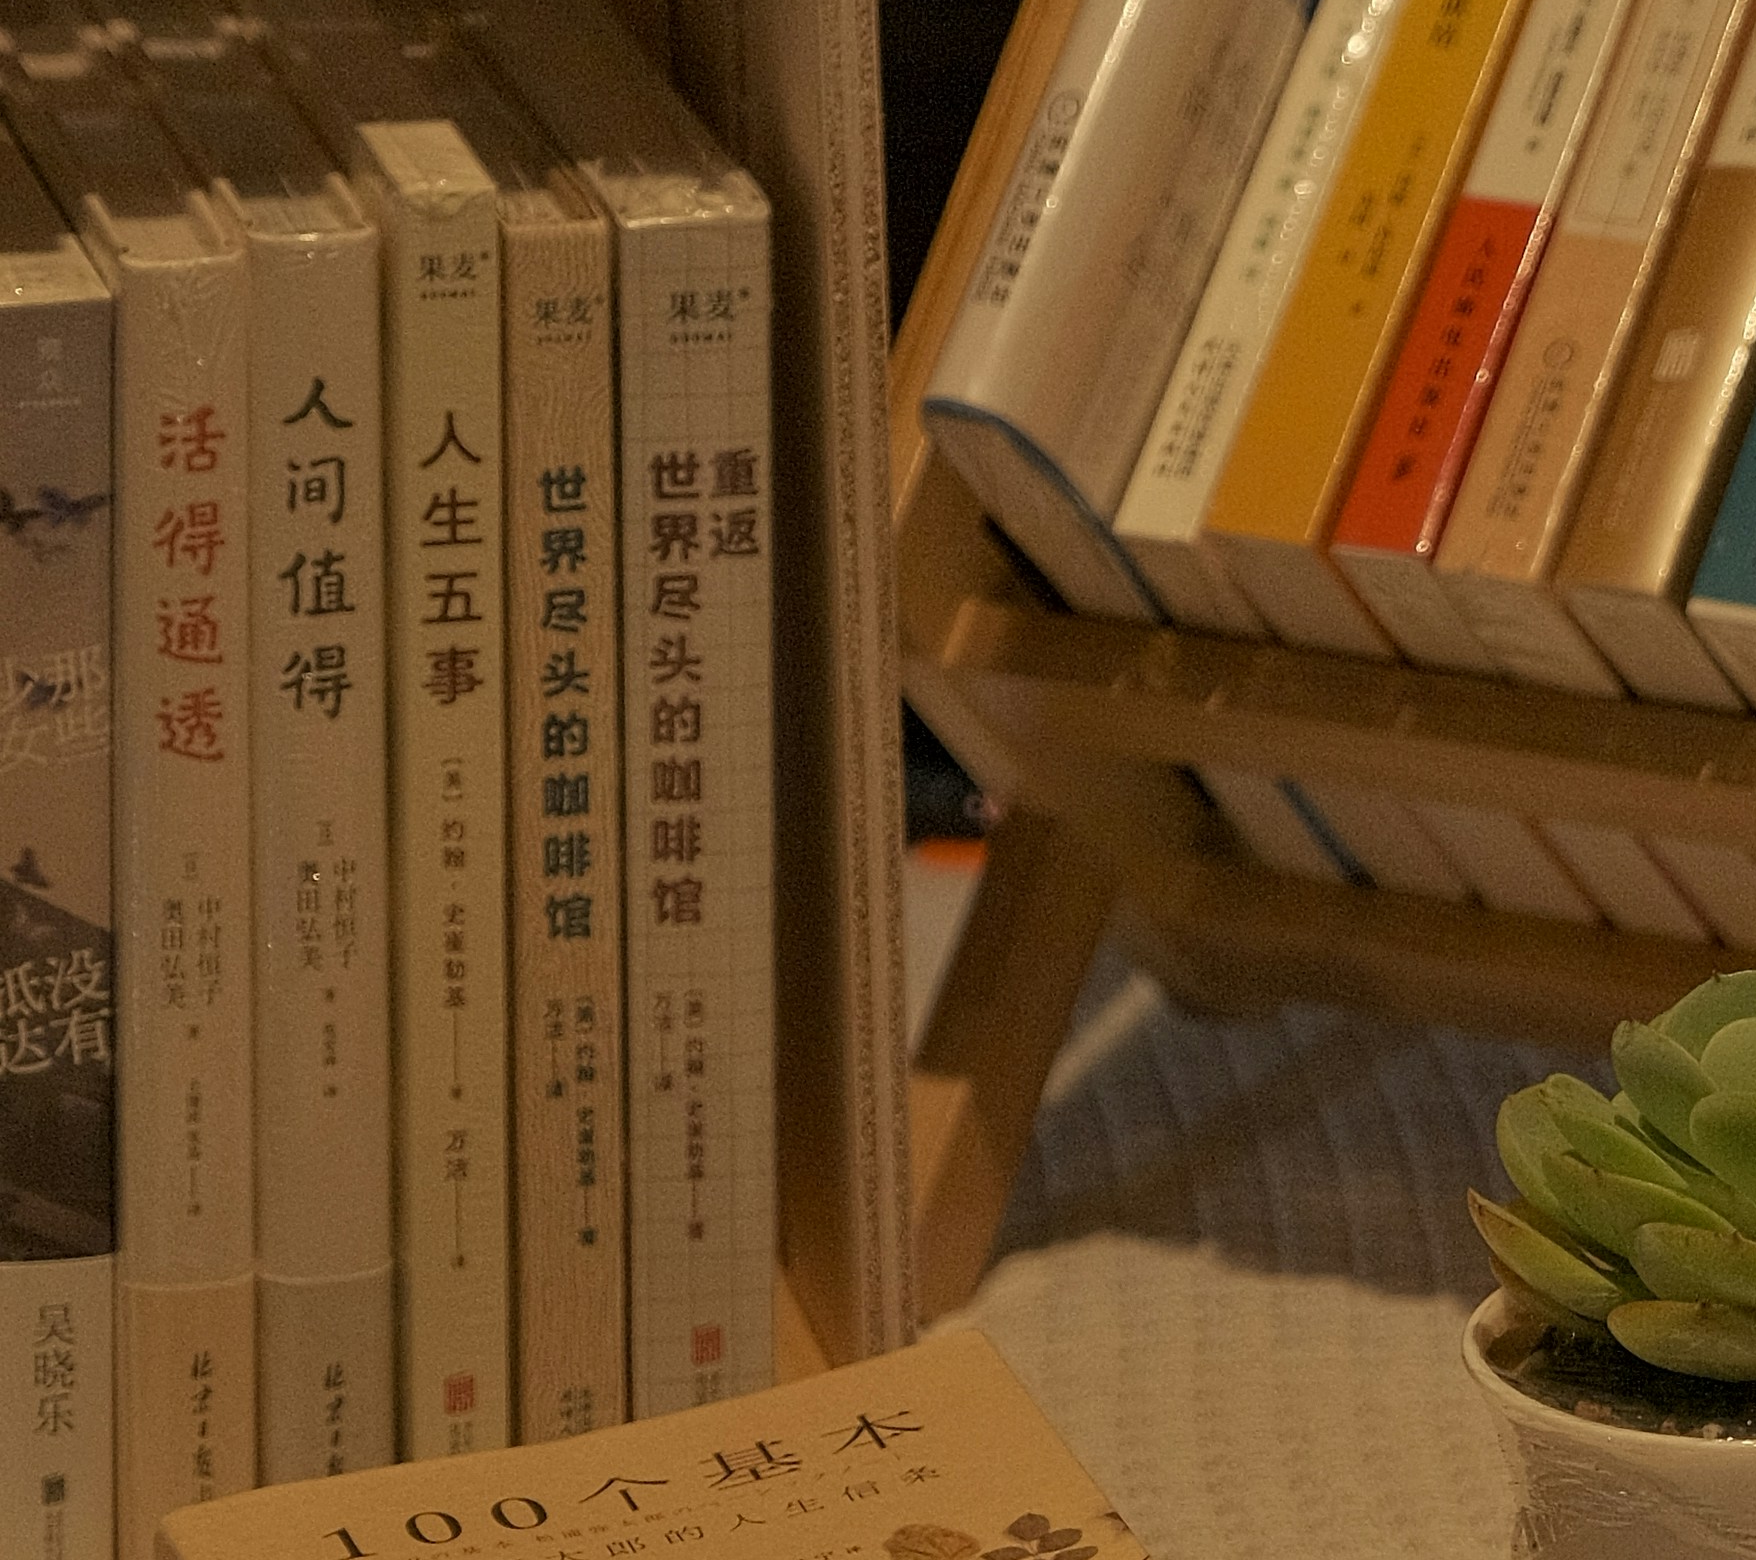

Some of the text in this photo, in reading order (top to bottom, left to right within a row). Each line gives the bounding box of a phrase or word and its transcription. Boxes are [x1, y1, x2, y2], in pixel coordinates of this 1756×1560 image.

[417, 252, 481, 283] 果麦
[535, 296, 595, 327] 果麦
[668, 288, 737, 324] 果麦
[278, 376, 358, 722] 人间值得
[419, 410, 484, 707] 人生五事
[708, 448, 760, 559] 重返
[153, 405, 228, 765] 活得通透
[536, 464, 593, 942] 世界尽头的咖啡馆
[648, 451, 704, 927] 世界尽头的咖啡馆
[160, 895, 187, 1009] 奥田弘美
[196, 895, 222, 1007] 中村恒子
[331, 857, 357, 972] 中村恒子
[45, 948, 108, 1070] 没有
[33, 1302, 76, 1437] 吴晓乐
